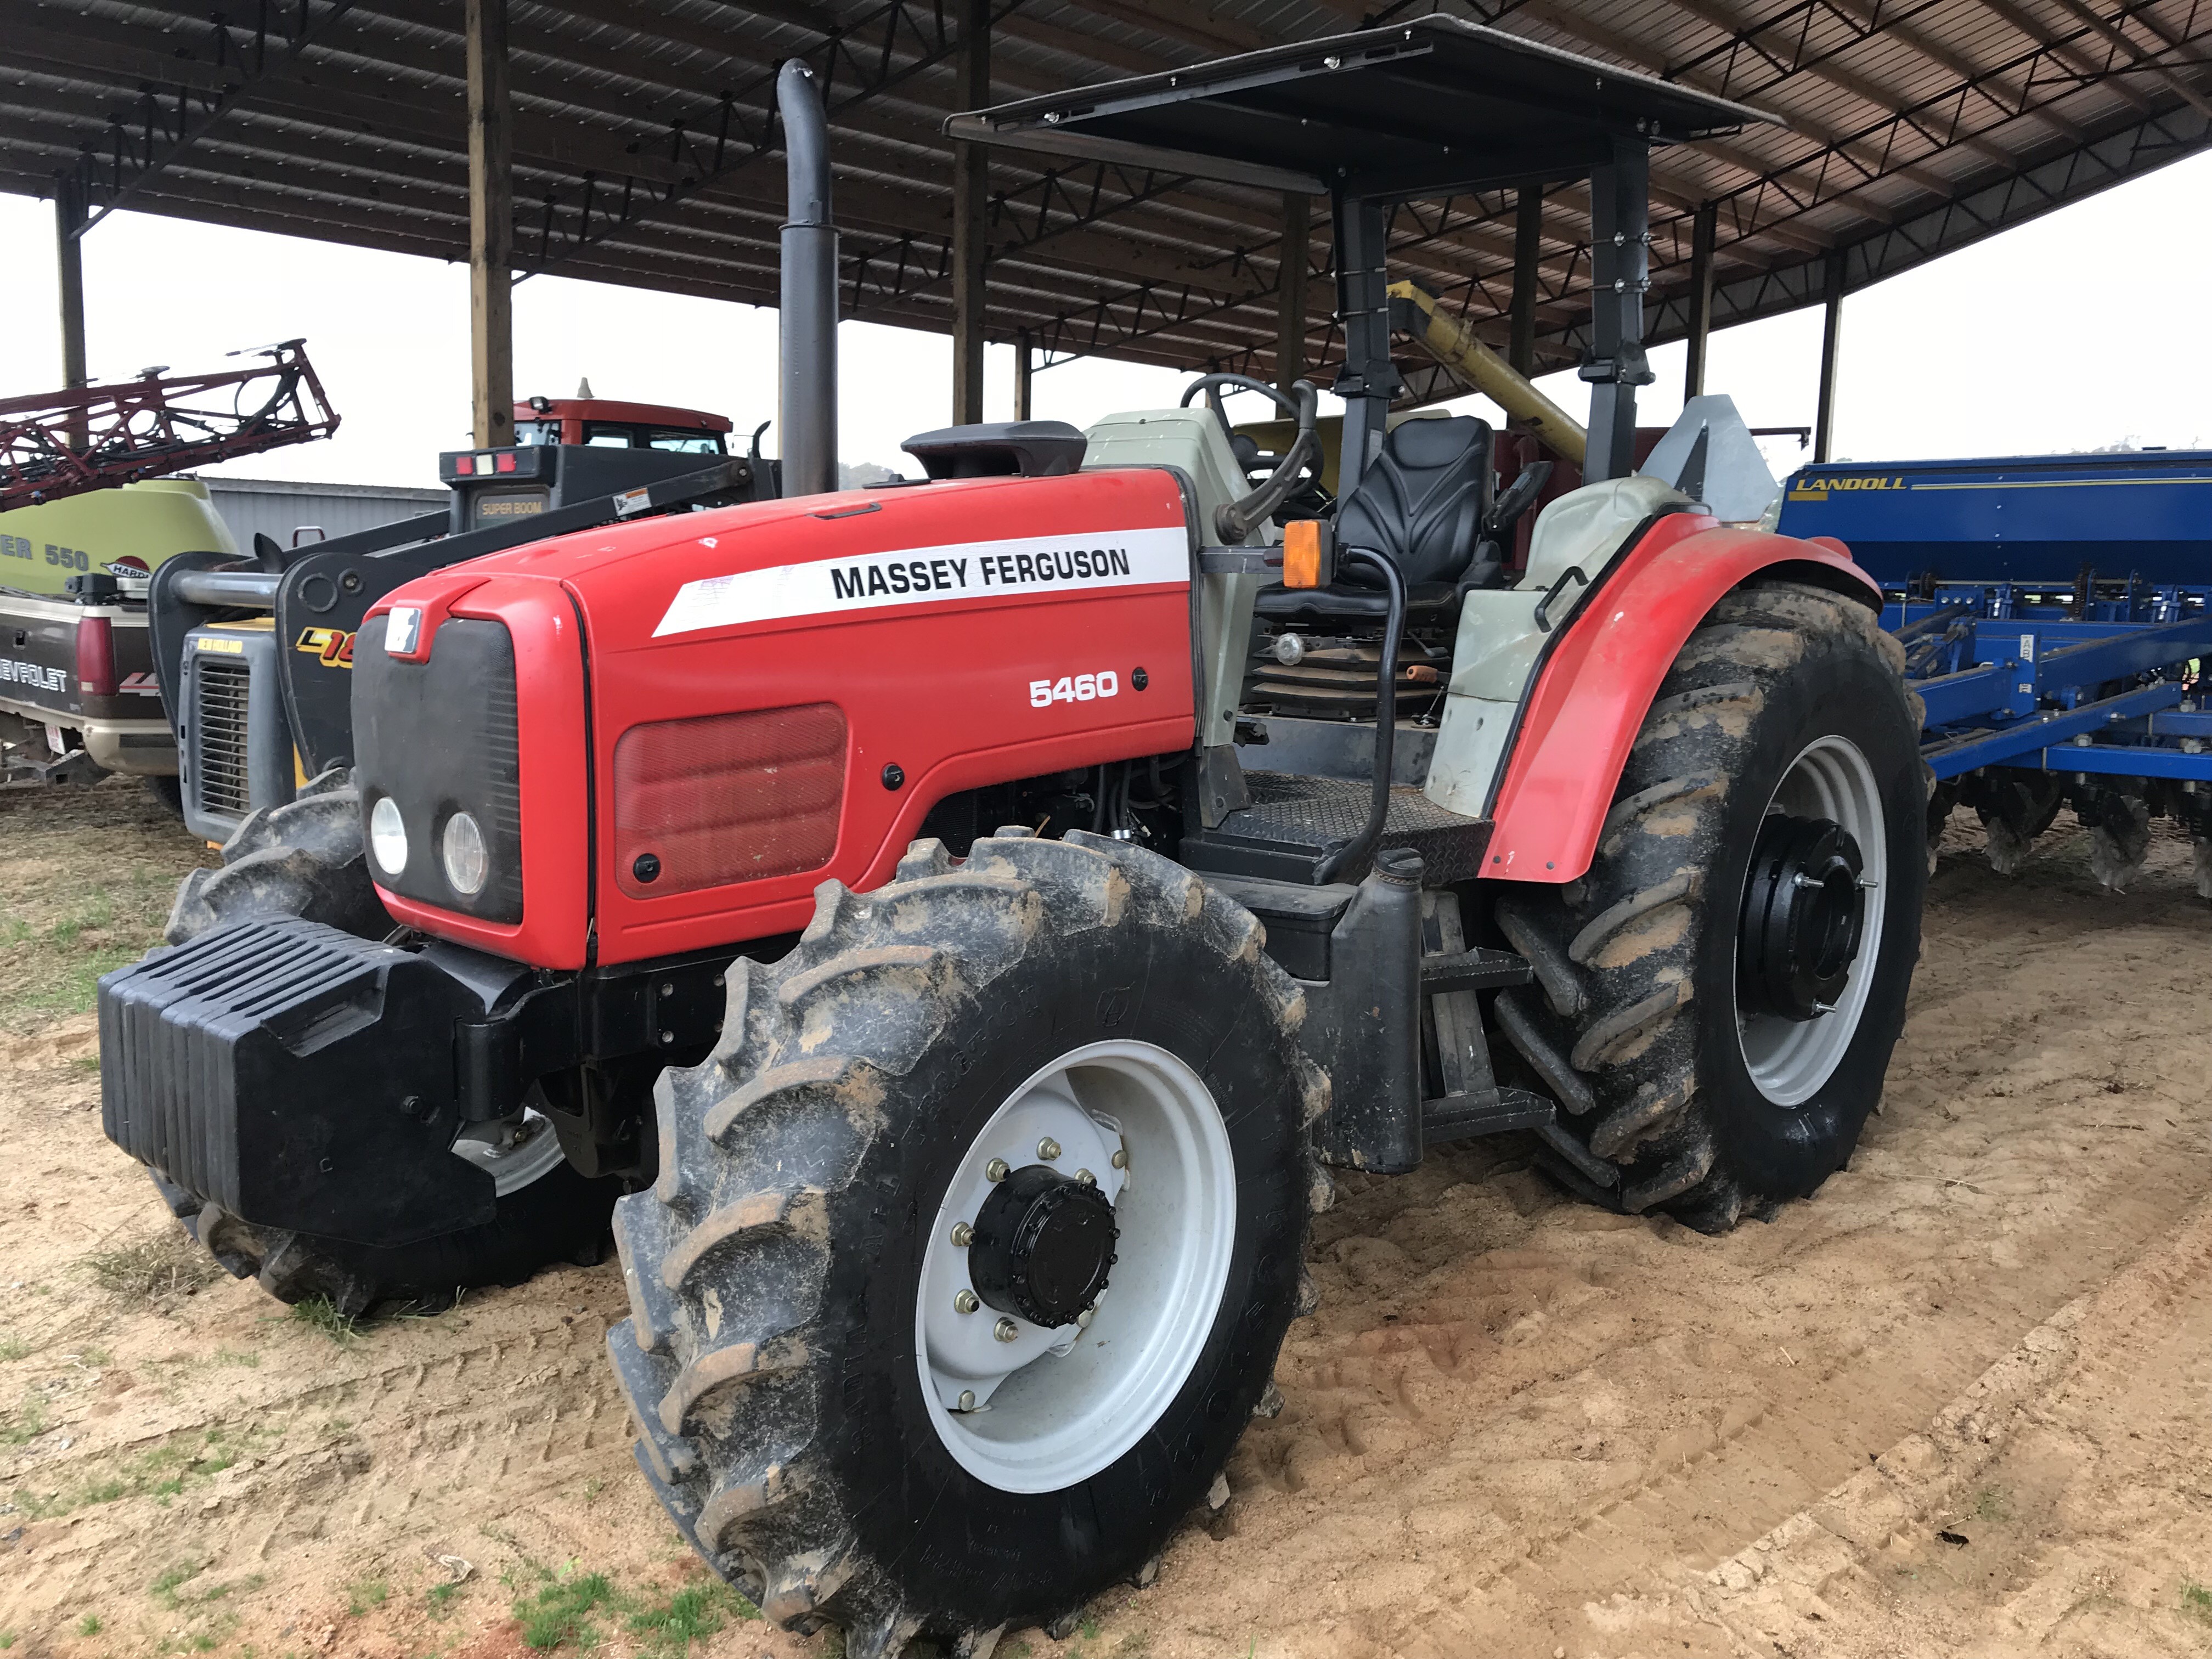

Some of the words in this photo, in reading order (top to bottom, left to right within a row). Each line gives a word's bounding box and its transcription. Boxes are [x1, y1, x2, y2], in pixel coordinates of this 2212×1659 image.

[1795, 477, 1908, 491] LANDOLL
[482, 503, 512, 515] SUPER
[514, 501, 542, 514] BOOM
[44, 544, 89, 572] 550
[831, 558, 967, 599] MASSEY
[982, 549, 1130, 585] FERGUSON
[0, 658, 66, 693] EVROLET
[1029, 670, 1119, 708] 5460
